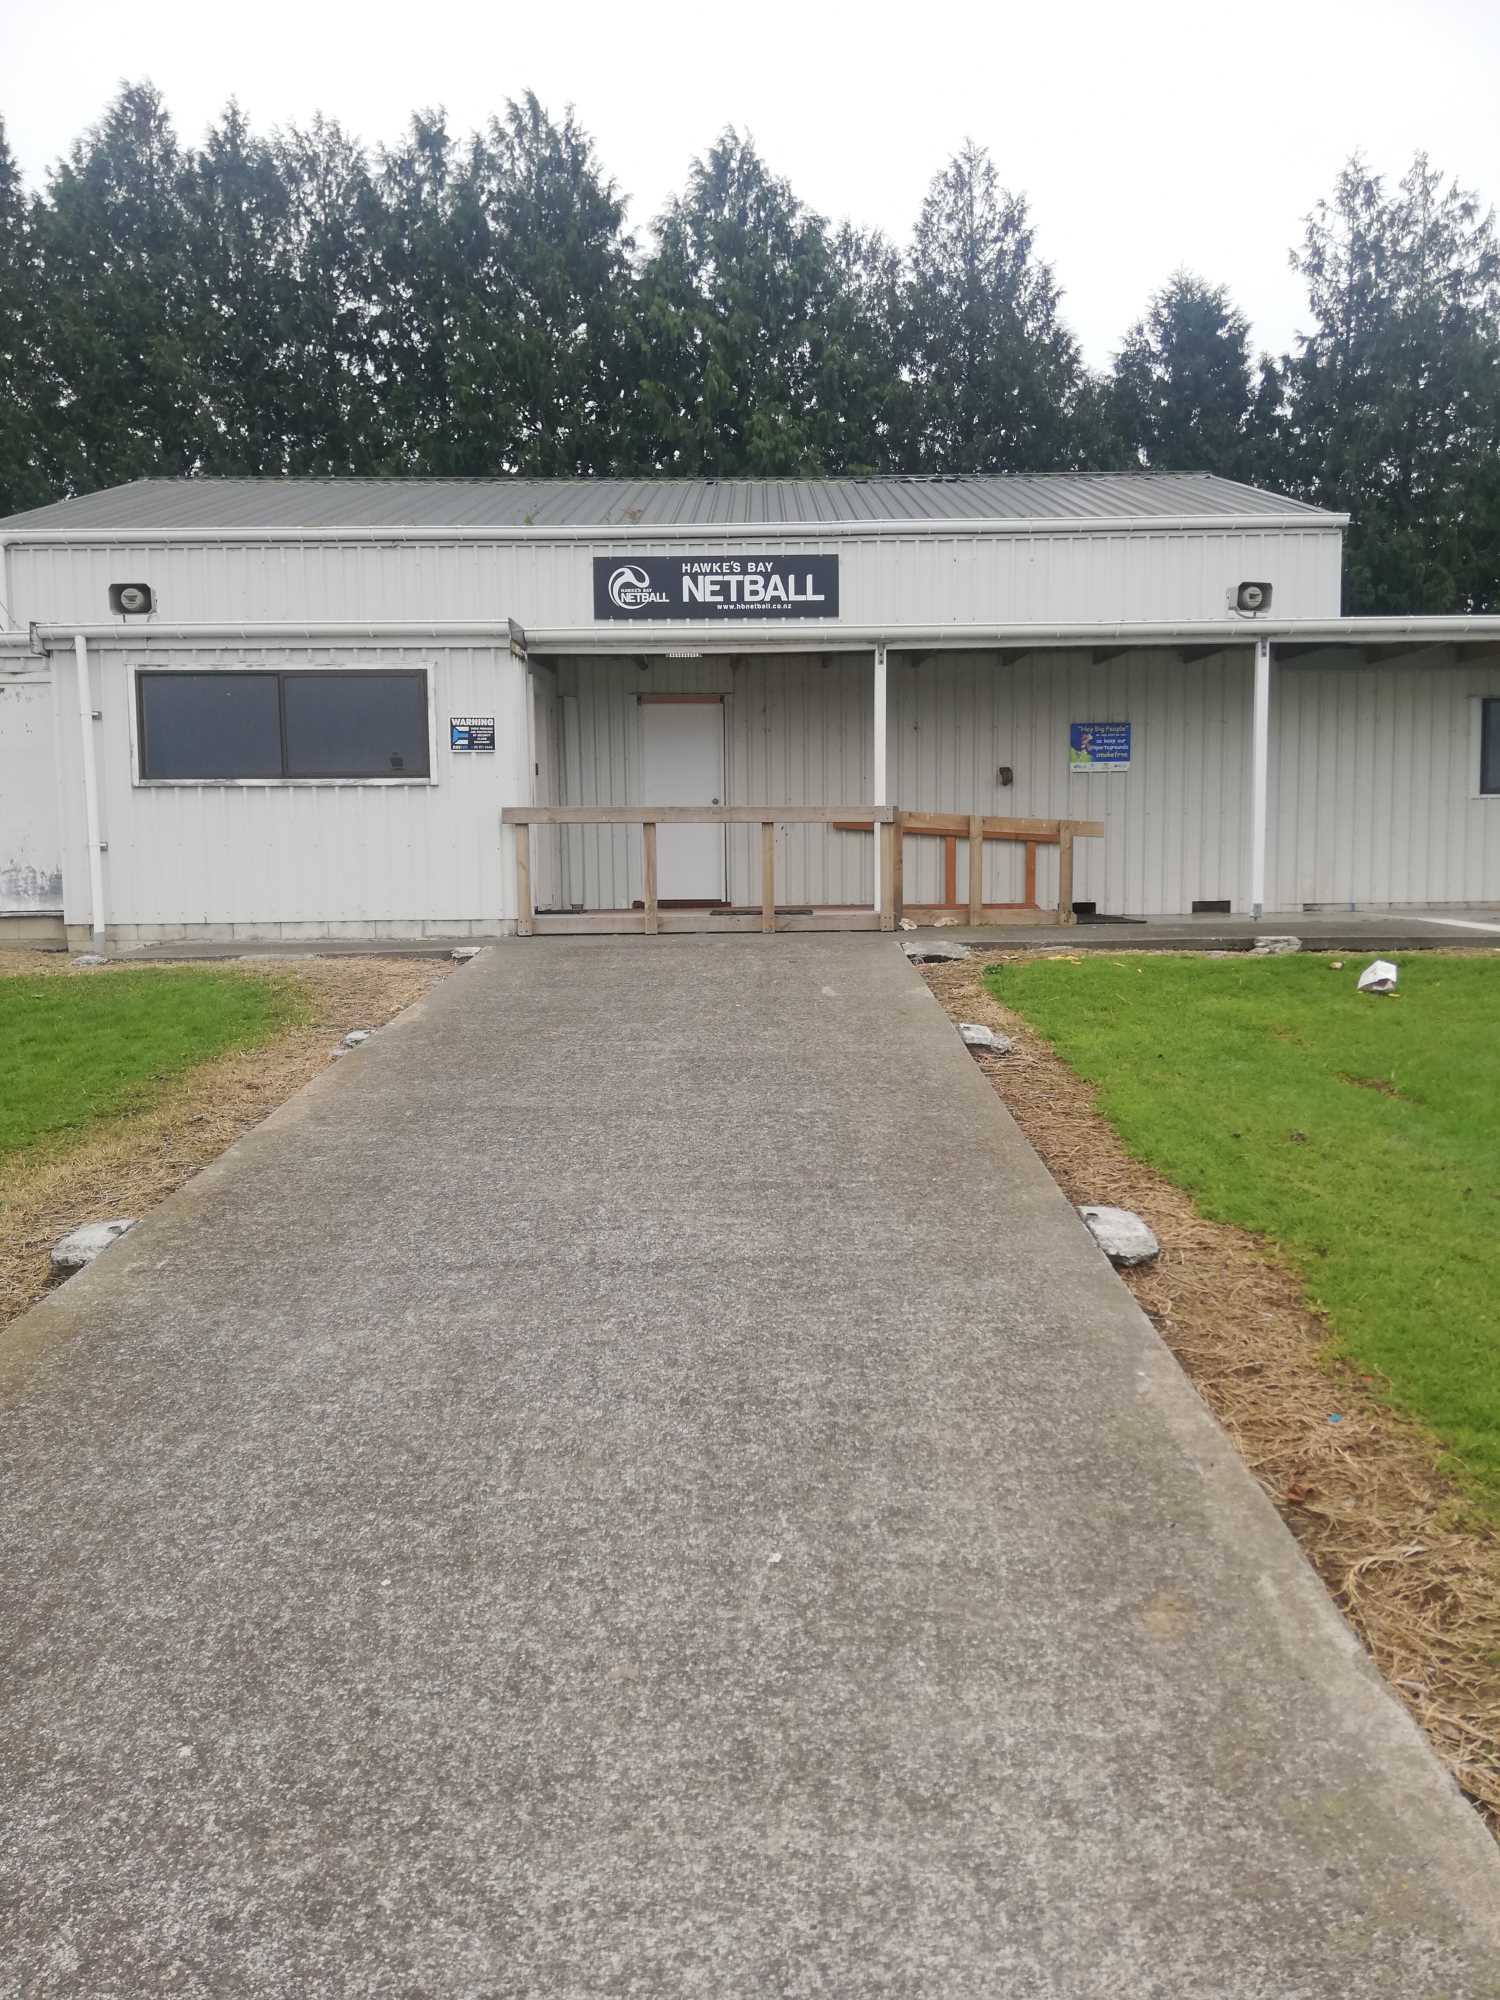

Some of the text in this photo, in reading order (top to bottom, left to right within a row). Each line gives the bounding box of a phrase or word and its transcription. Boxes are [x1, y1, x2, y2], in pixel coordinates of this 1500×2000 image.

[682, 561, 774, 574] HAWKE'S BAY
[682, 574, 825, 602] NETBALL
[620, 592, 670, 603] NETBALL
[716, 603, 793, 611] www.hbnetball.co.nz
[451, 718, 494, 726] WARNING
